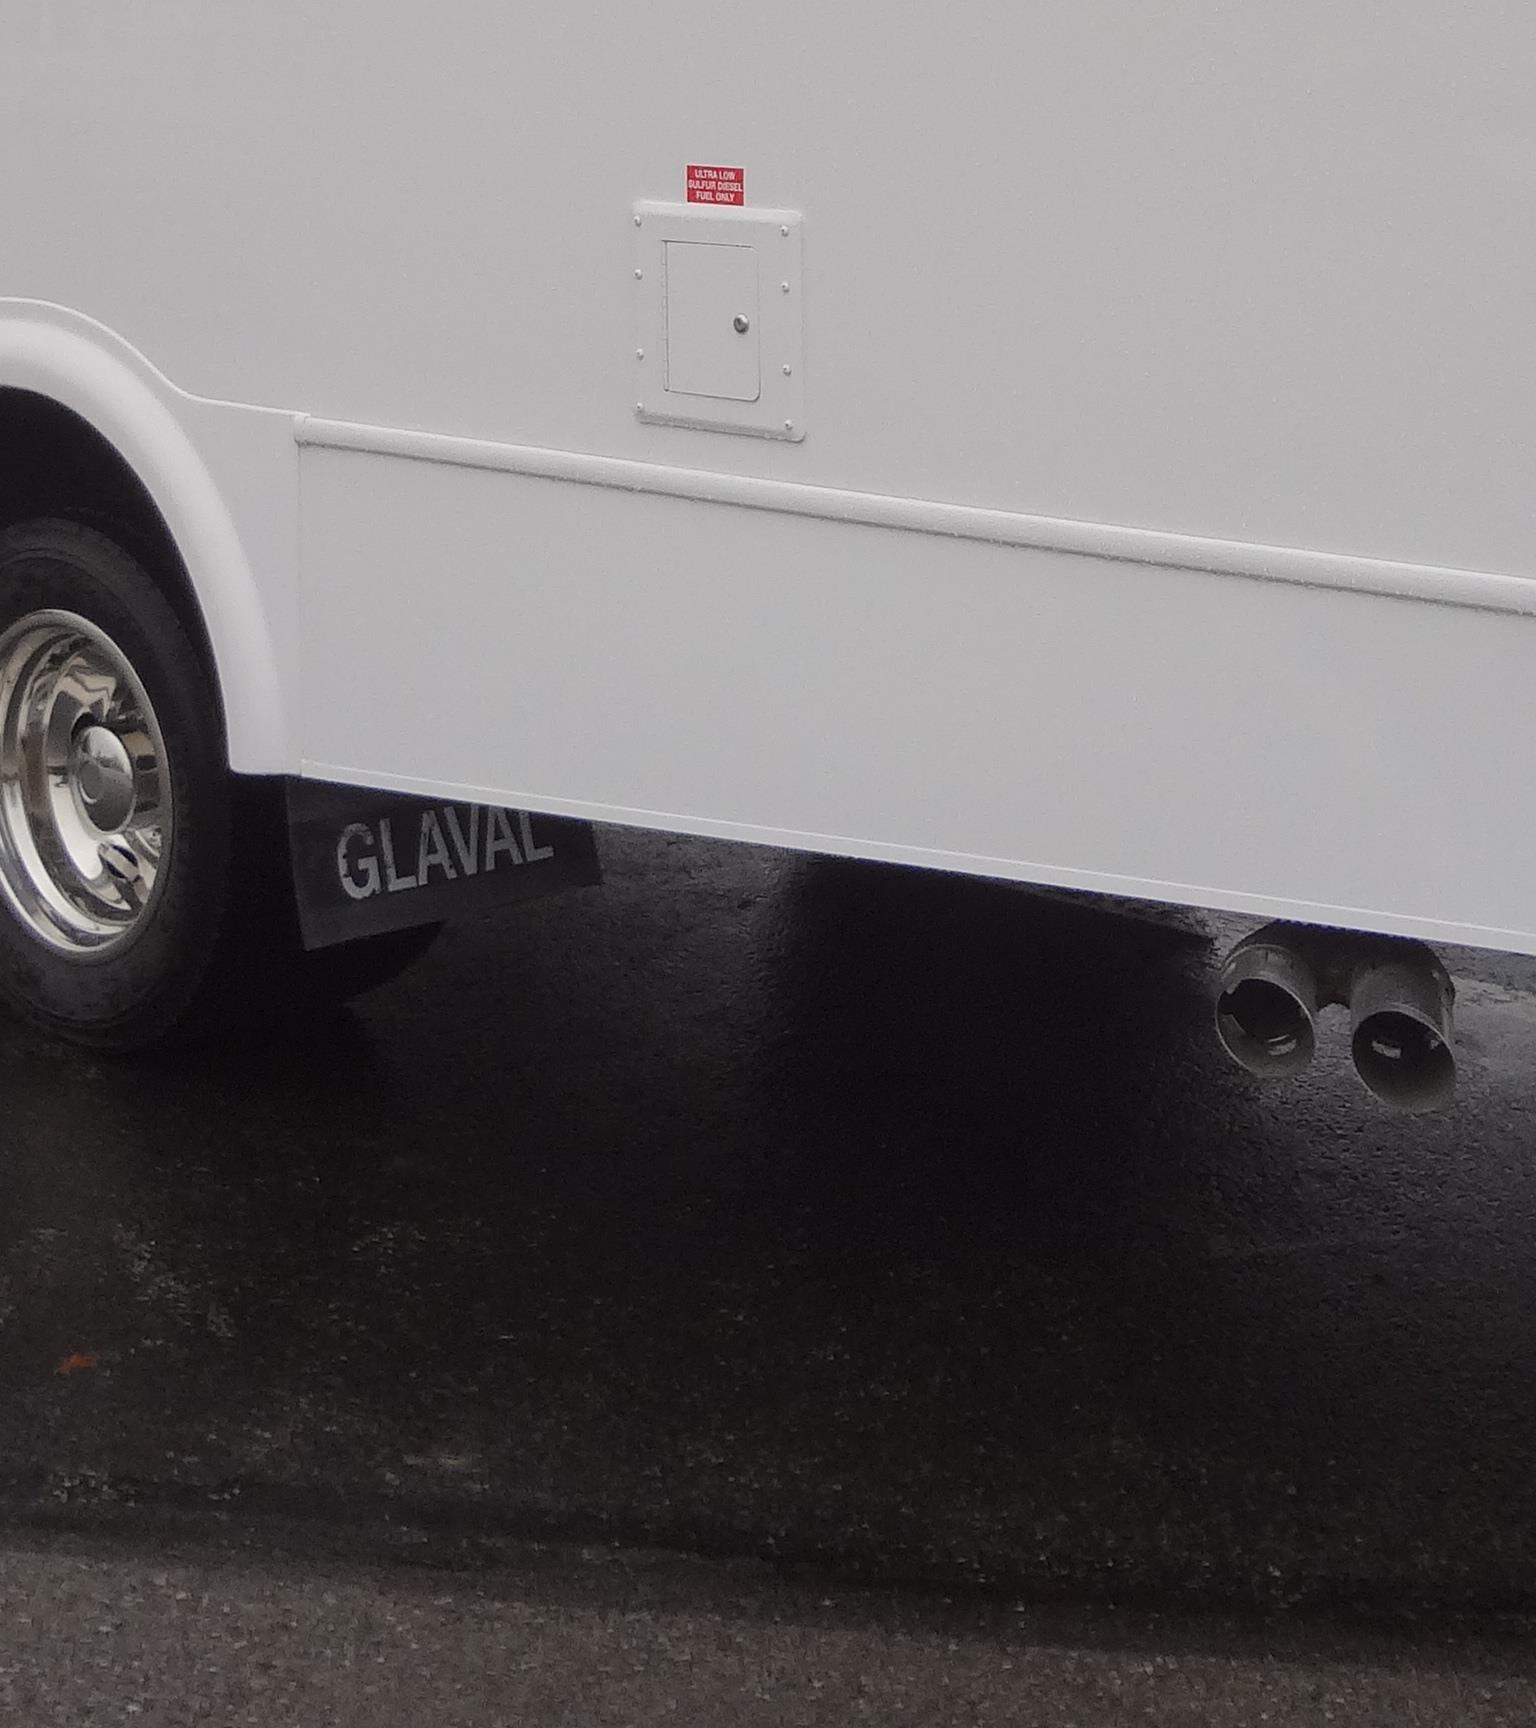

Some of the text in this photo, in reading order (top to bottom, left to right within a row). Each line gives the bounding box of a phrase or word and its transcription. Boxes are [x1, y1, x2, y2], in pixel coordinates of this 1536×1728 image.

[694, 169, 736, 180] ULTRA LOW
[688, 179, 743, 192] SULFUR DIESEL
[696, 191, 735, 202] FUEL ONLY
[336, 802, 555, 901] GLAVAL
